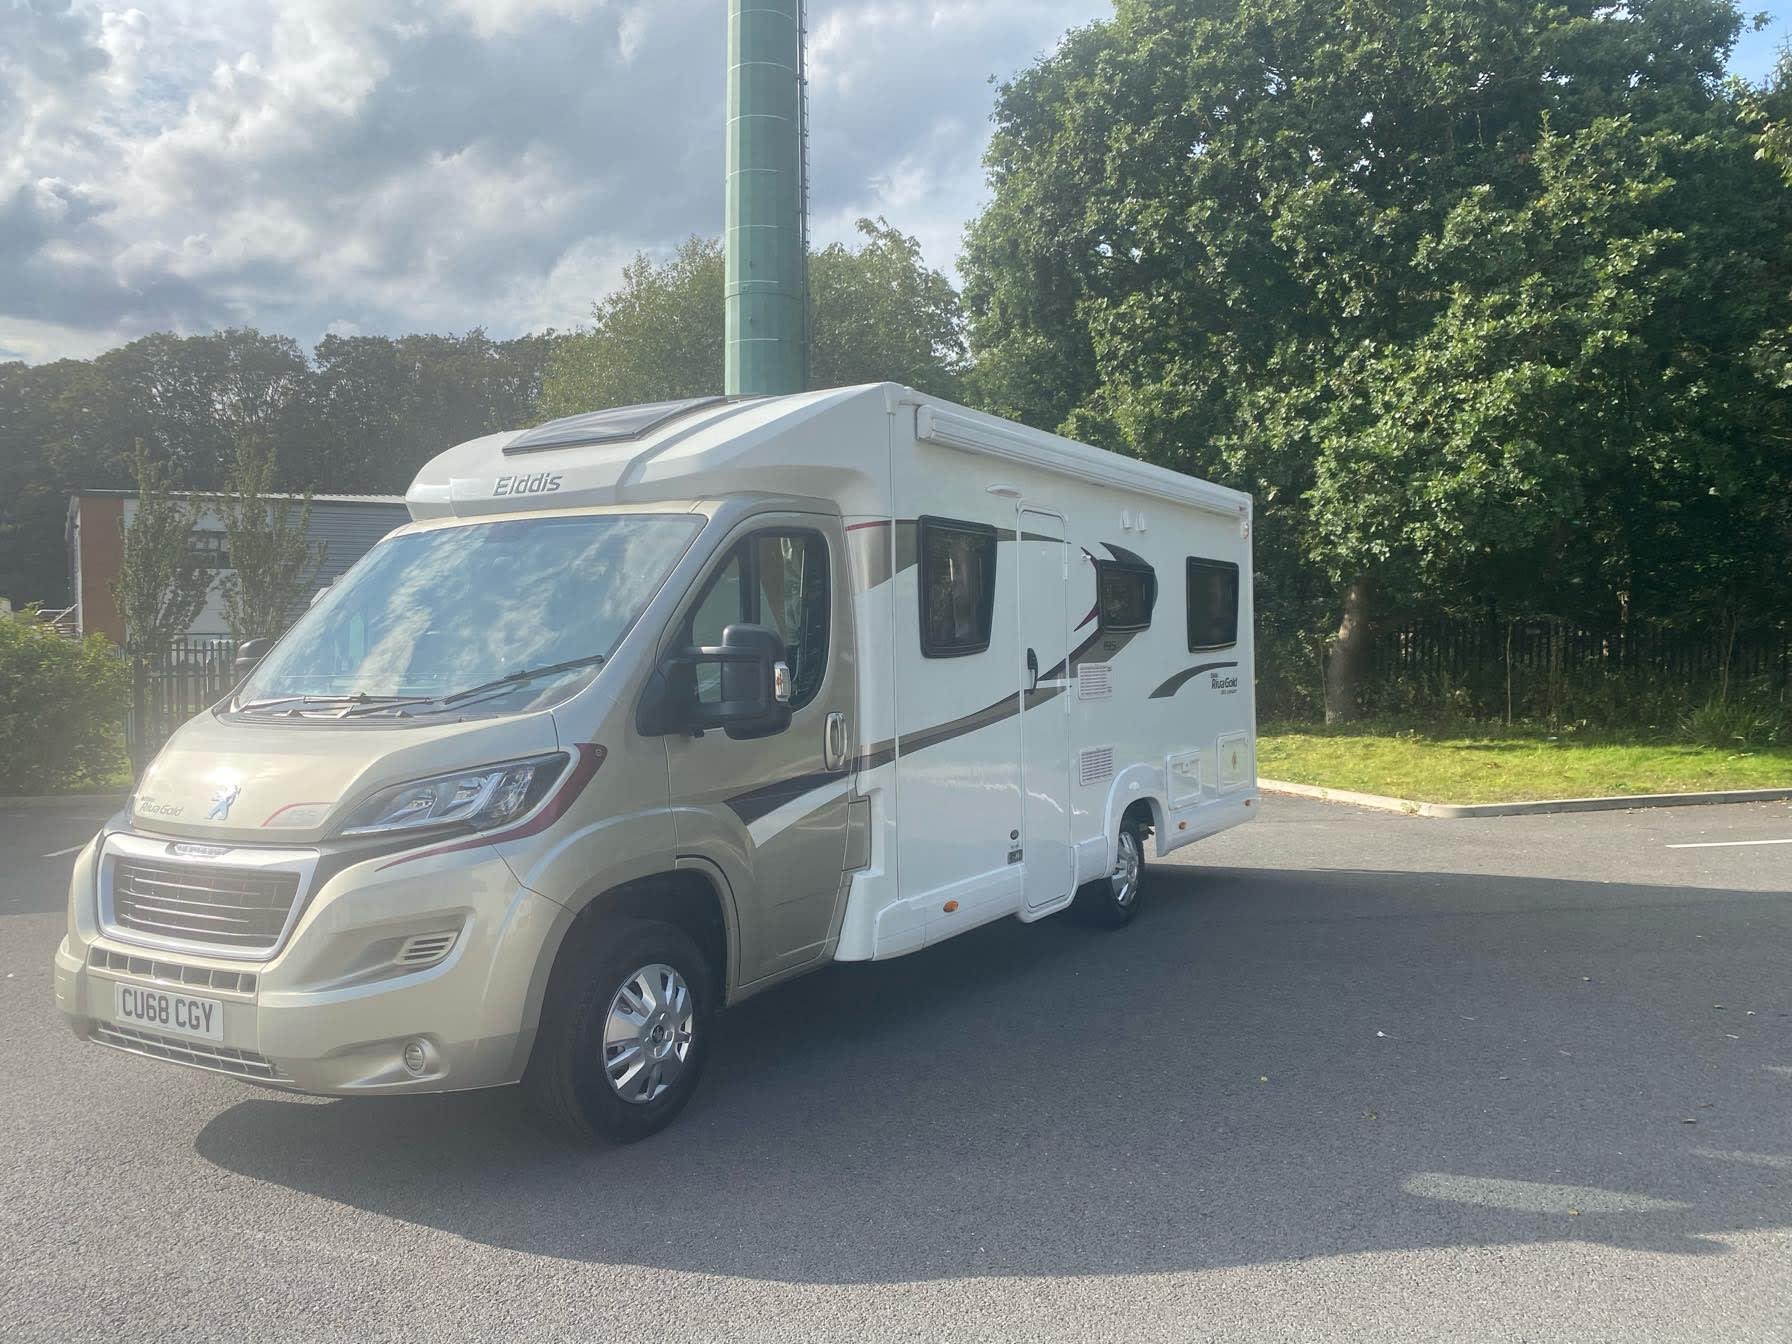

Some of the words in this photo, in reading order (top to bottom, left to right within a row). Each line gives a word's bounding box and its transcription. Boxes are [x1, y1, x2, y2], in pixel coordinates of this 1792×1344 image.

[493, 472, 563, 496] Elddis
[122, 988, 169, 1024] CU68
[175, 999, 213, 1032] CGY
